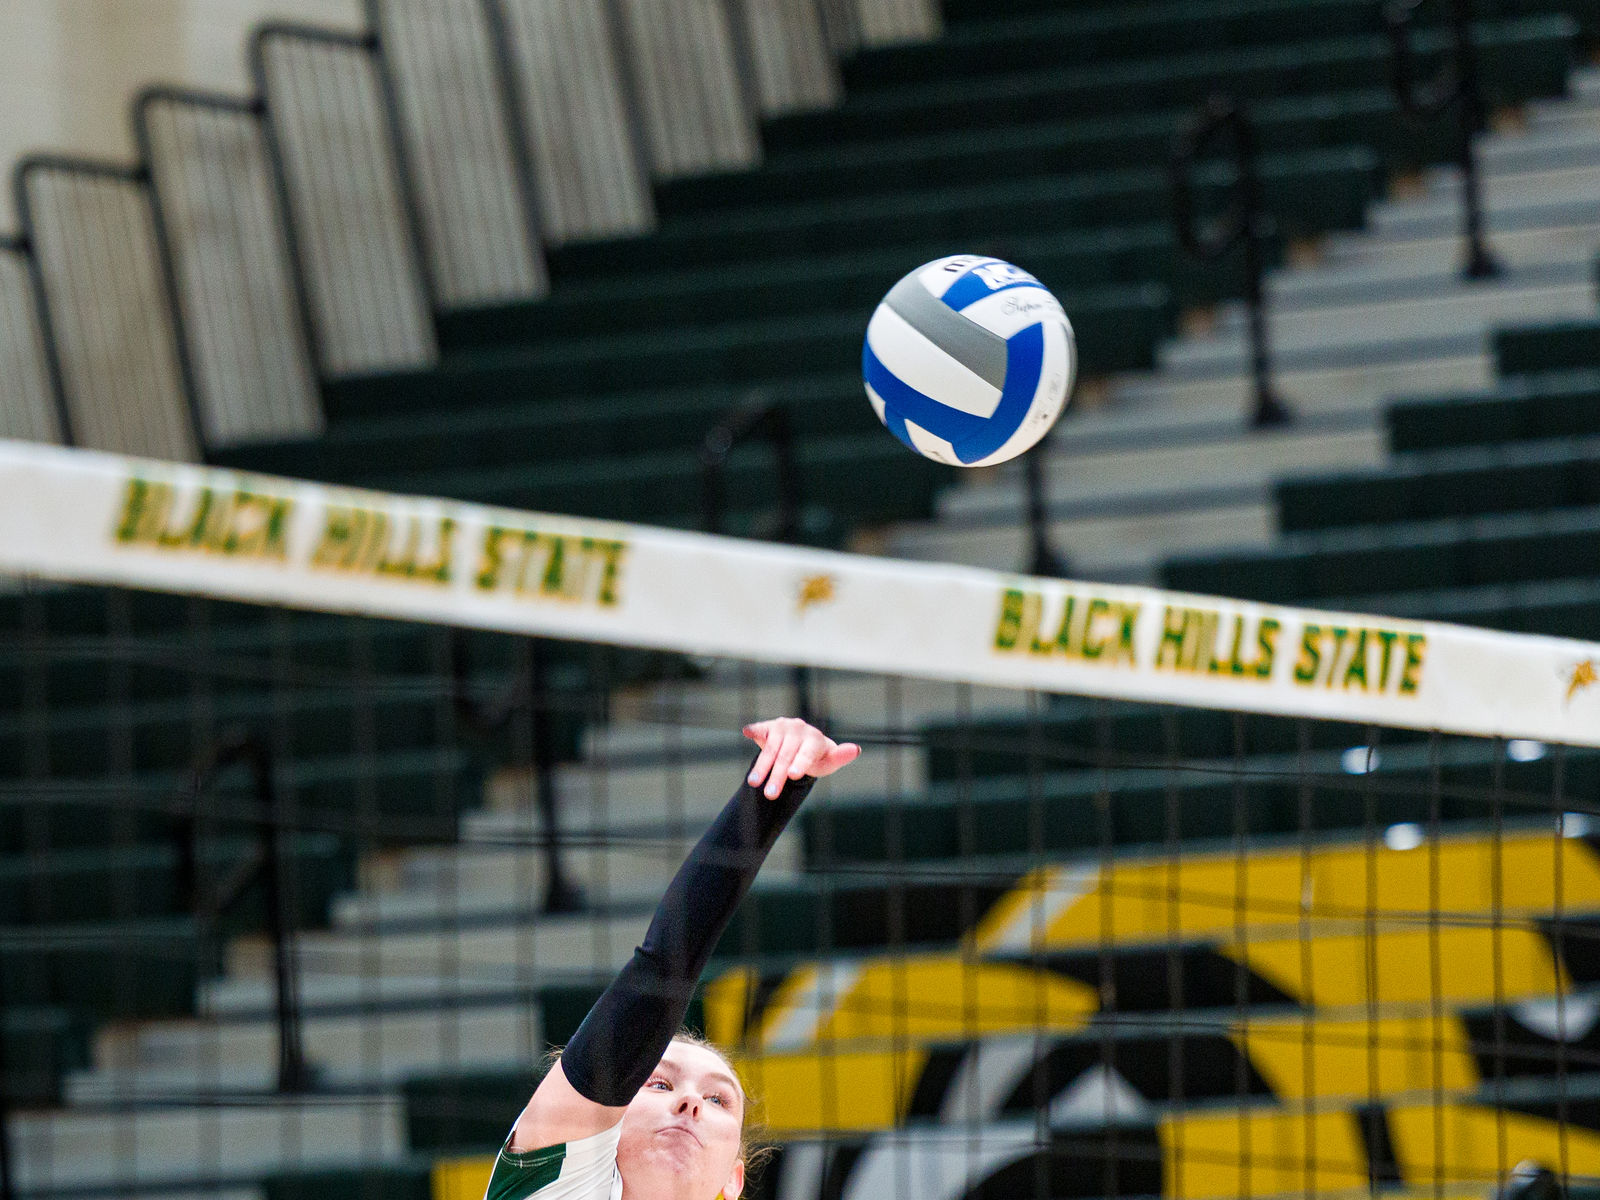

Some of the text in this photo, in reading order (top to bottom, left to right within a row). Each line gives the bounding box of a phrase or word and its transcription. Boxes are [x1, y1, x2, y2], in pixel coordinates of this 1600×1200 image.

[303, 500, 458, 584] HILLS
[473, 523, 628, 606] STATE
[992, 589, 1428, 696] BLACK HILLS STATE
